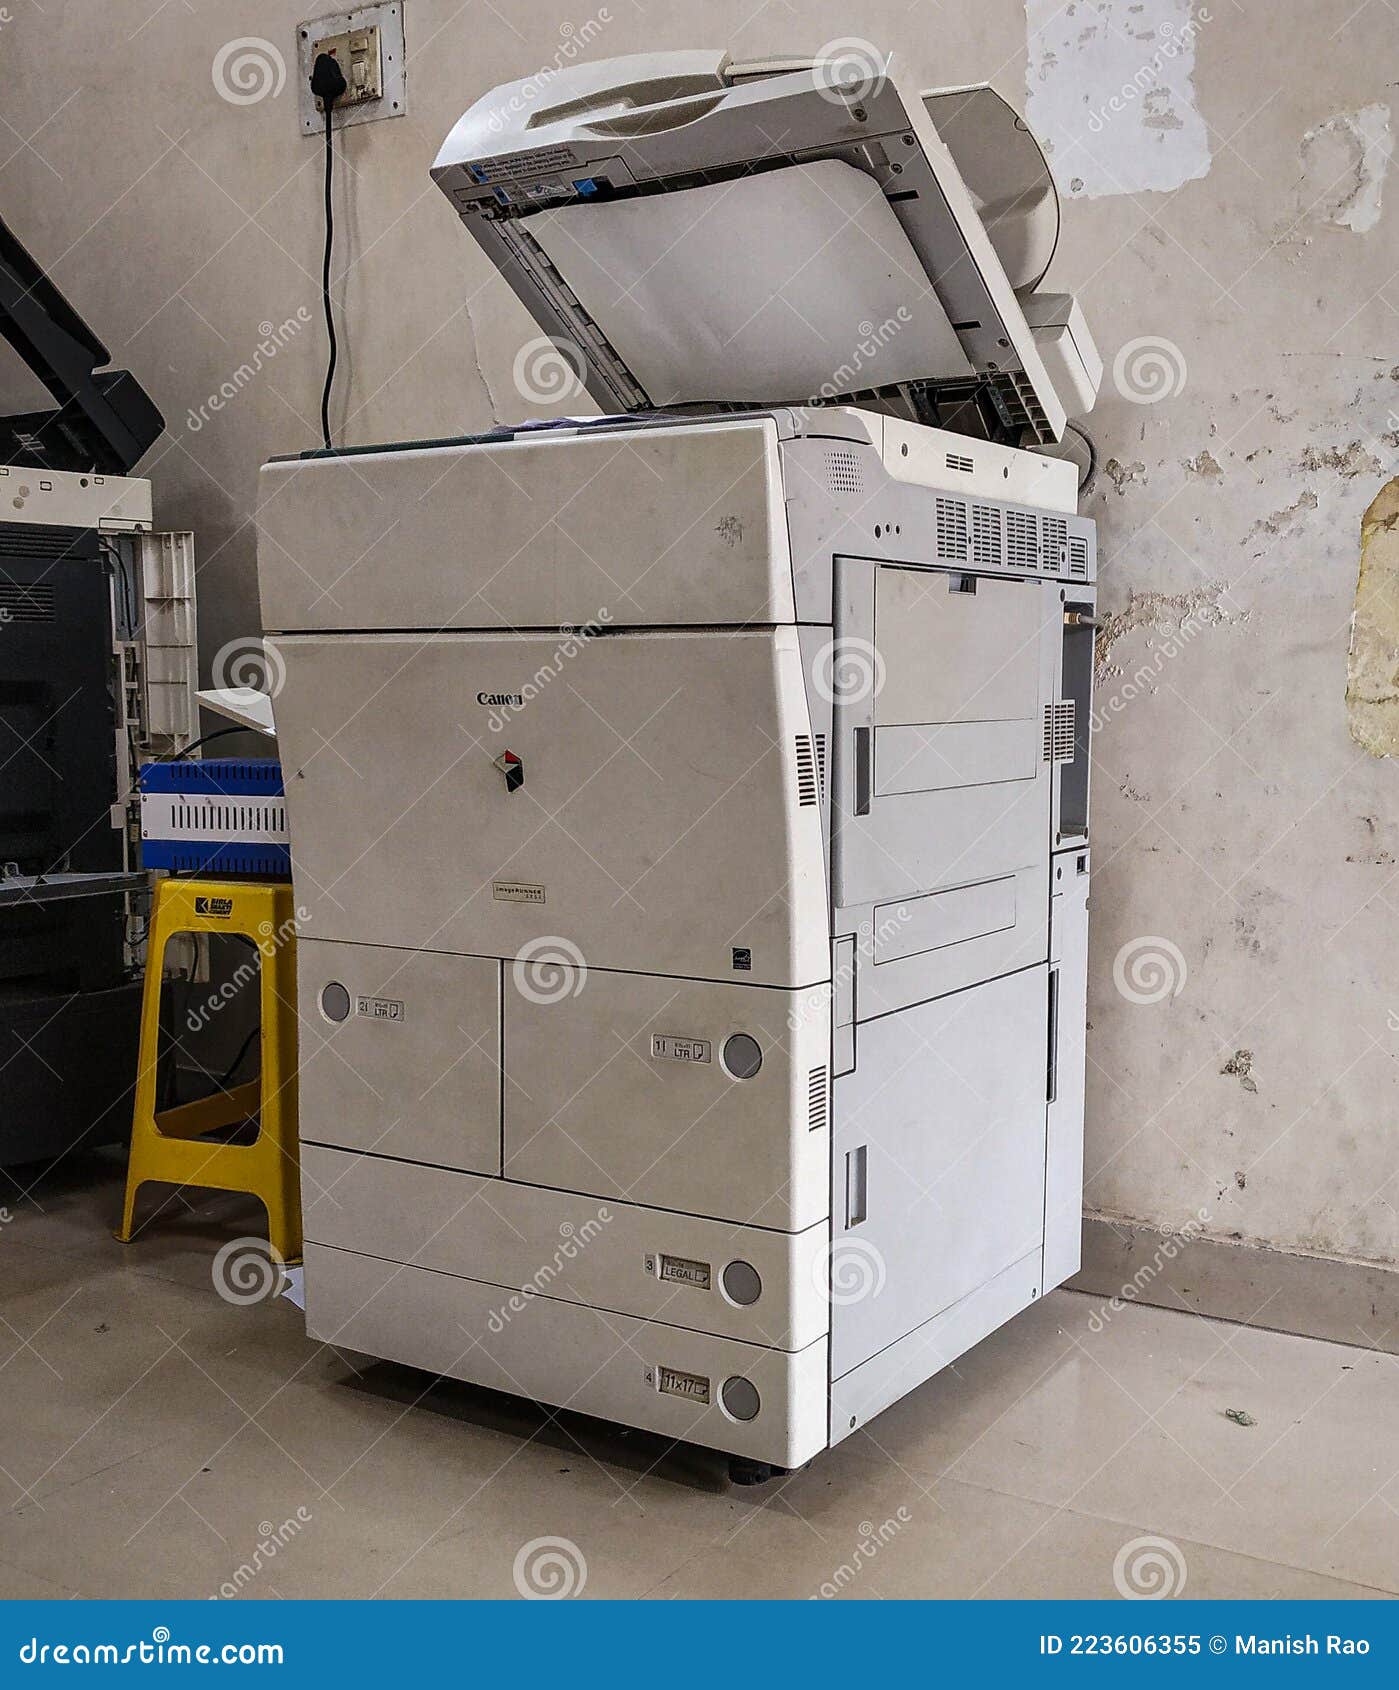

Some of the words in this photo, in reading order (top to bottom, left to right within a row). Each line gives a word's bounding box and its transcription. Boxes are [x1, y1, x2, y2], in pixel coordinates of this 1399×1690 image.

[477, 692, 523, 706] Canon
[674, 1048, 690, 1058] LTR
[646, 1260, 653, 1271] 3
[665, 1265, 694, 1281] LEGAL
[646, 1372, 652, 1382] 4
[665, 1374, 695, 1393] 11x17
